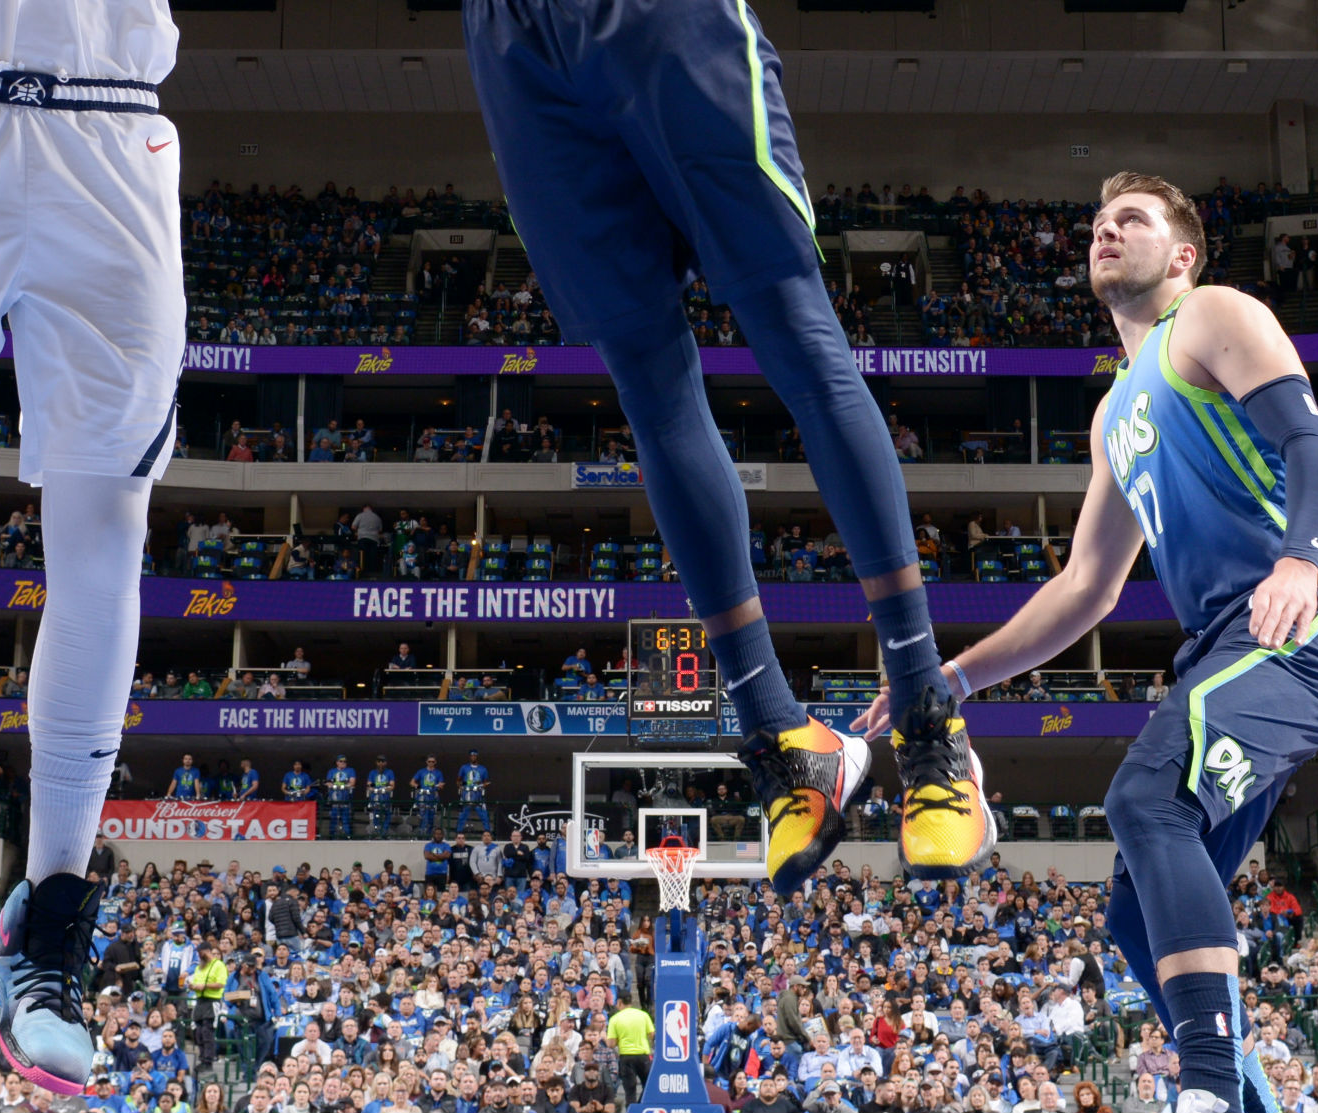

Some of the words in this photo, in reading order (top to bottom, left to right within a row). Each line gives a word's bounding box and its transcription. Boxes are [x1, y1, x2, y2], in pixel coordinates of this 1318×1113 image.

[1072, 147, 1089, 156] 319
[354, 353, 393, 374] Takis
[881, 349, 987, 373] INTENSITY!
[576, 465, 638, 484] Service
[1128, 471, 1164, 549] 77
[183, 588, 238, 618] Takis
[353, 587, 415, 618] FACE
[420, 587, 469, 618] THE
[477, 587, 616, 618] INTENSITY!
[656, 628, 706, 651] 6:31
[428, 707, 472, 716] TIMEOUTS
[485, 707, 513, 716] FOULS
[567, 706, 625, 716] MAVERICKS
[814, 708, 843, 717] FOULS
[654, 700, 712, 712] TISSOT
[219, 707, 260, 729] FACE
[265, 707, 297, 729] THE
[302, 707, 389, 729] INTENSITY!
[445, 718, 453, 731] 7
[493, 718, 504, 731] 0
[587, 718, 605, 732] 16
[1040, 713, 1073, 736] Takis
[151, 800, 245, 820] Budweiser
[95, 818, 183, 839] OUND
[205, 819, 309, 839] STAGE
[659, 1074, 689, 1093] @NBA
